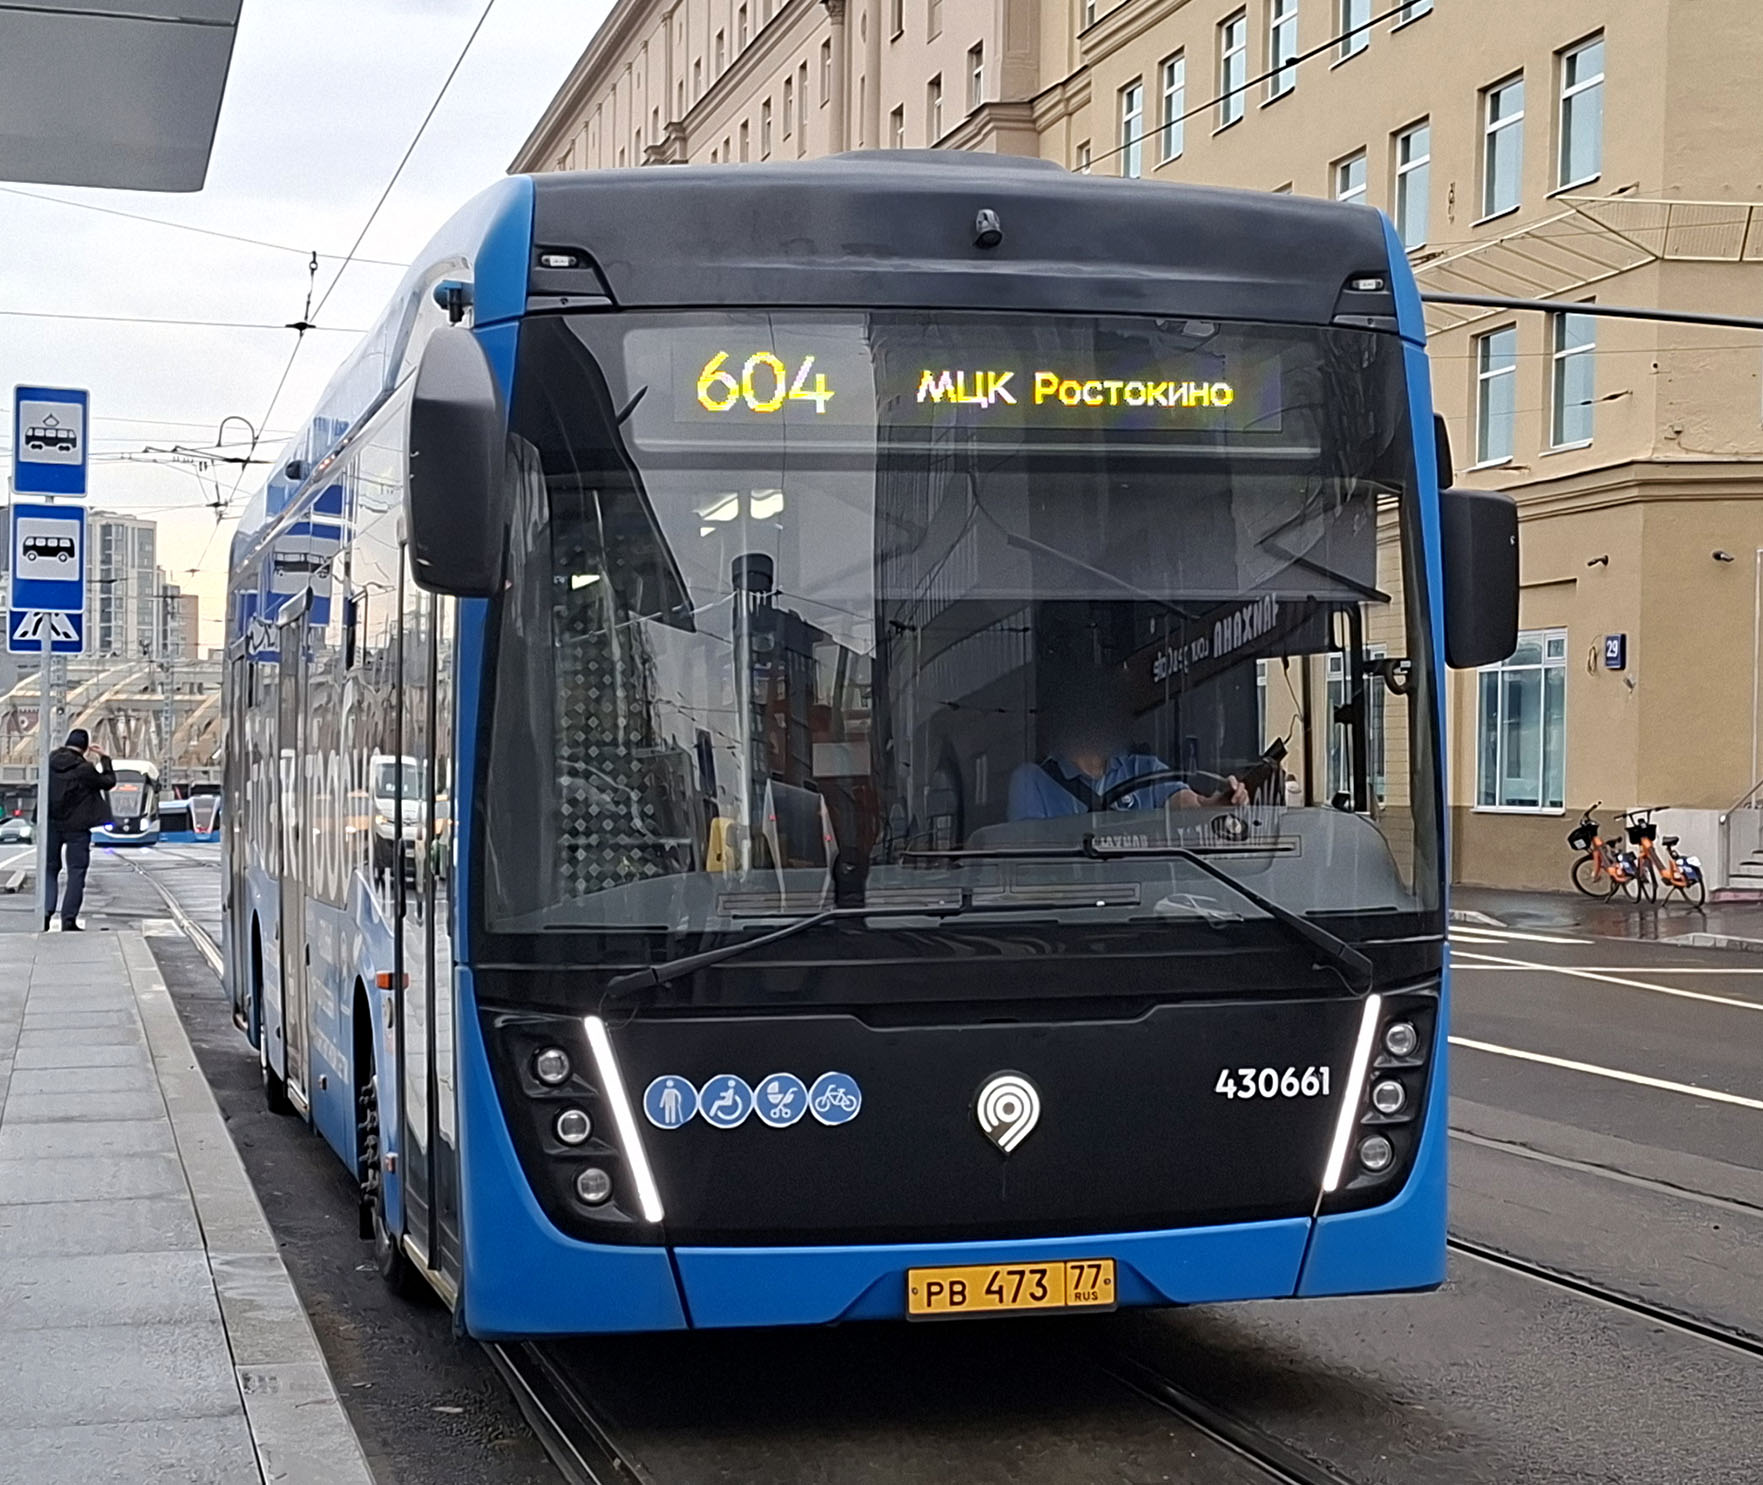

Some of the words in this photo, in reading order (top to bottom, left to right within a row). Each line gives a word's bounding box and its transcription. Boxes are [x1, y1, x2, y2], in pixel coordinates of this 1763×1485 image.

[696, 351, 834, 415] 604
[916, 370, 1017, 409] МЦК
[1034, 371, 1233, 408] Ростокино
[1606, 640, 1618, 657] 29
[1215, 1066, 1330, 1099] 430661
[985, 1268, 1048, 1304] 473
[1070, 1264, 1102, 1290] 77
[1074, 1291, 1099, 1302] RUS
